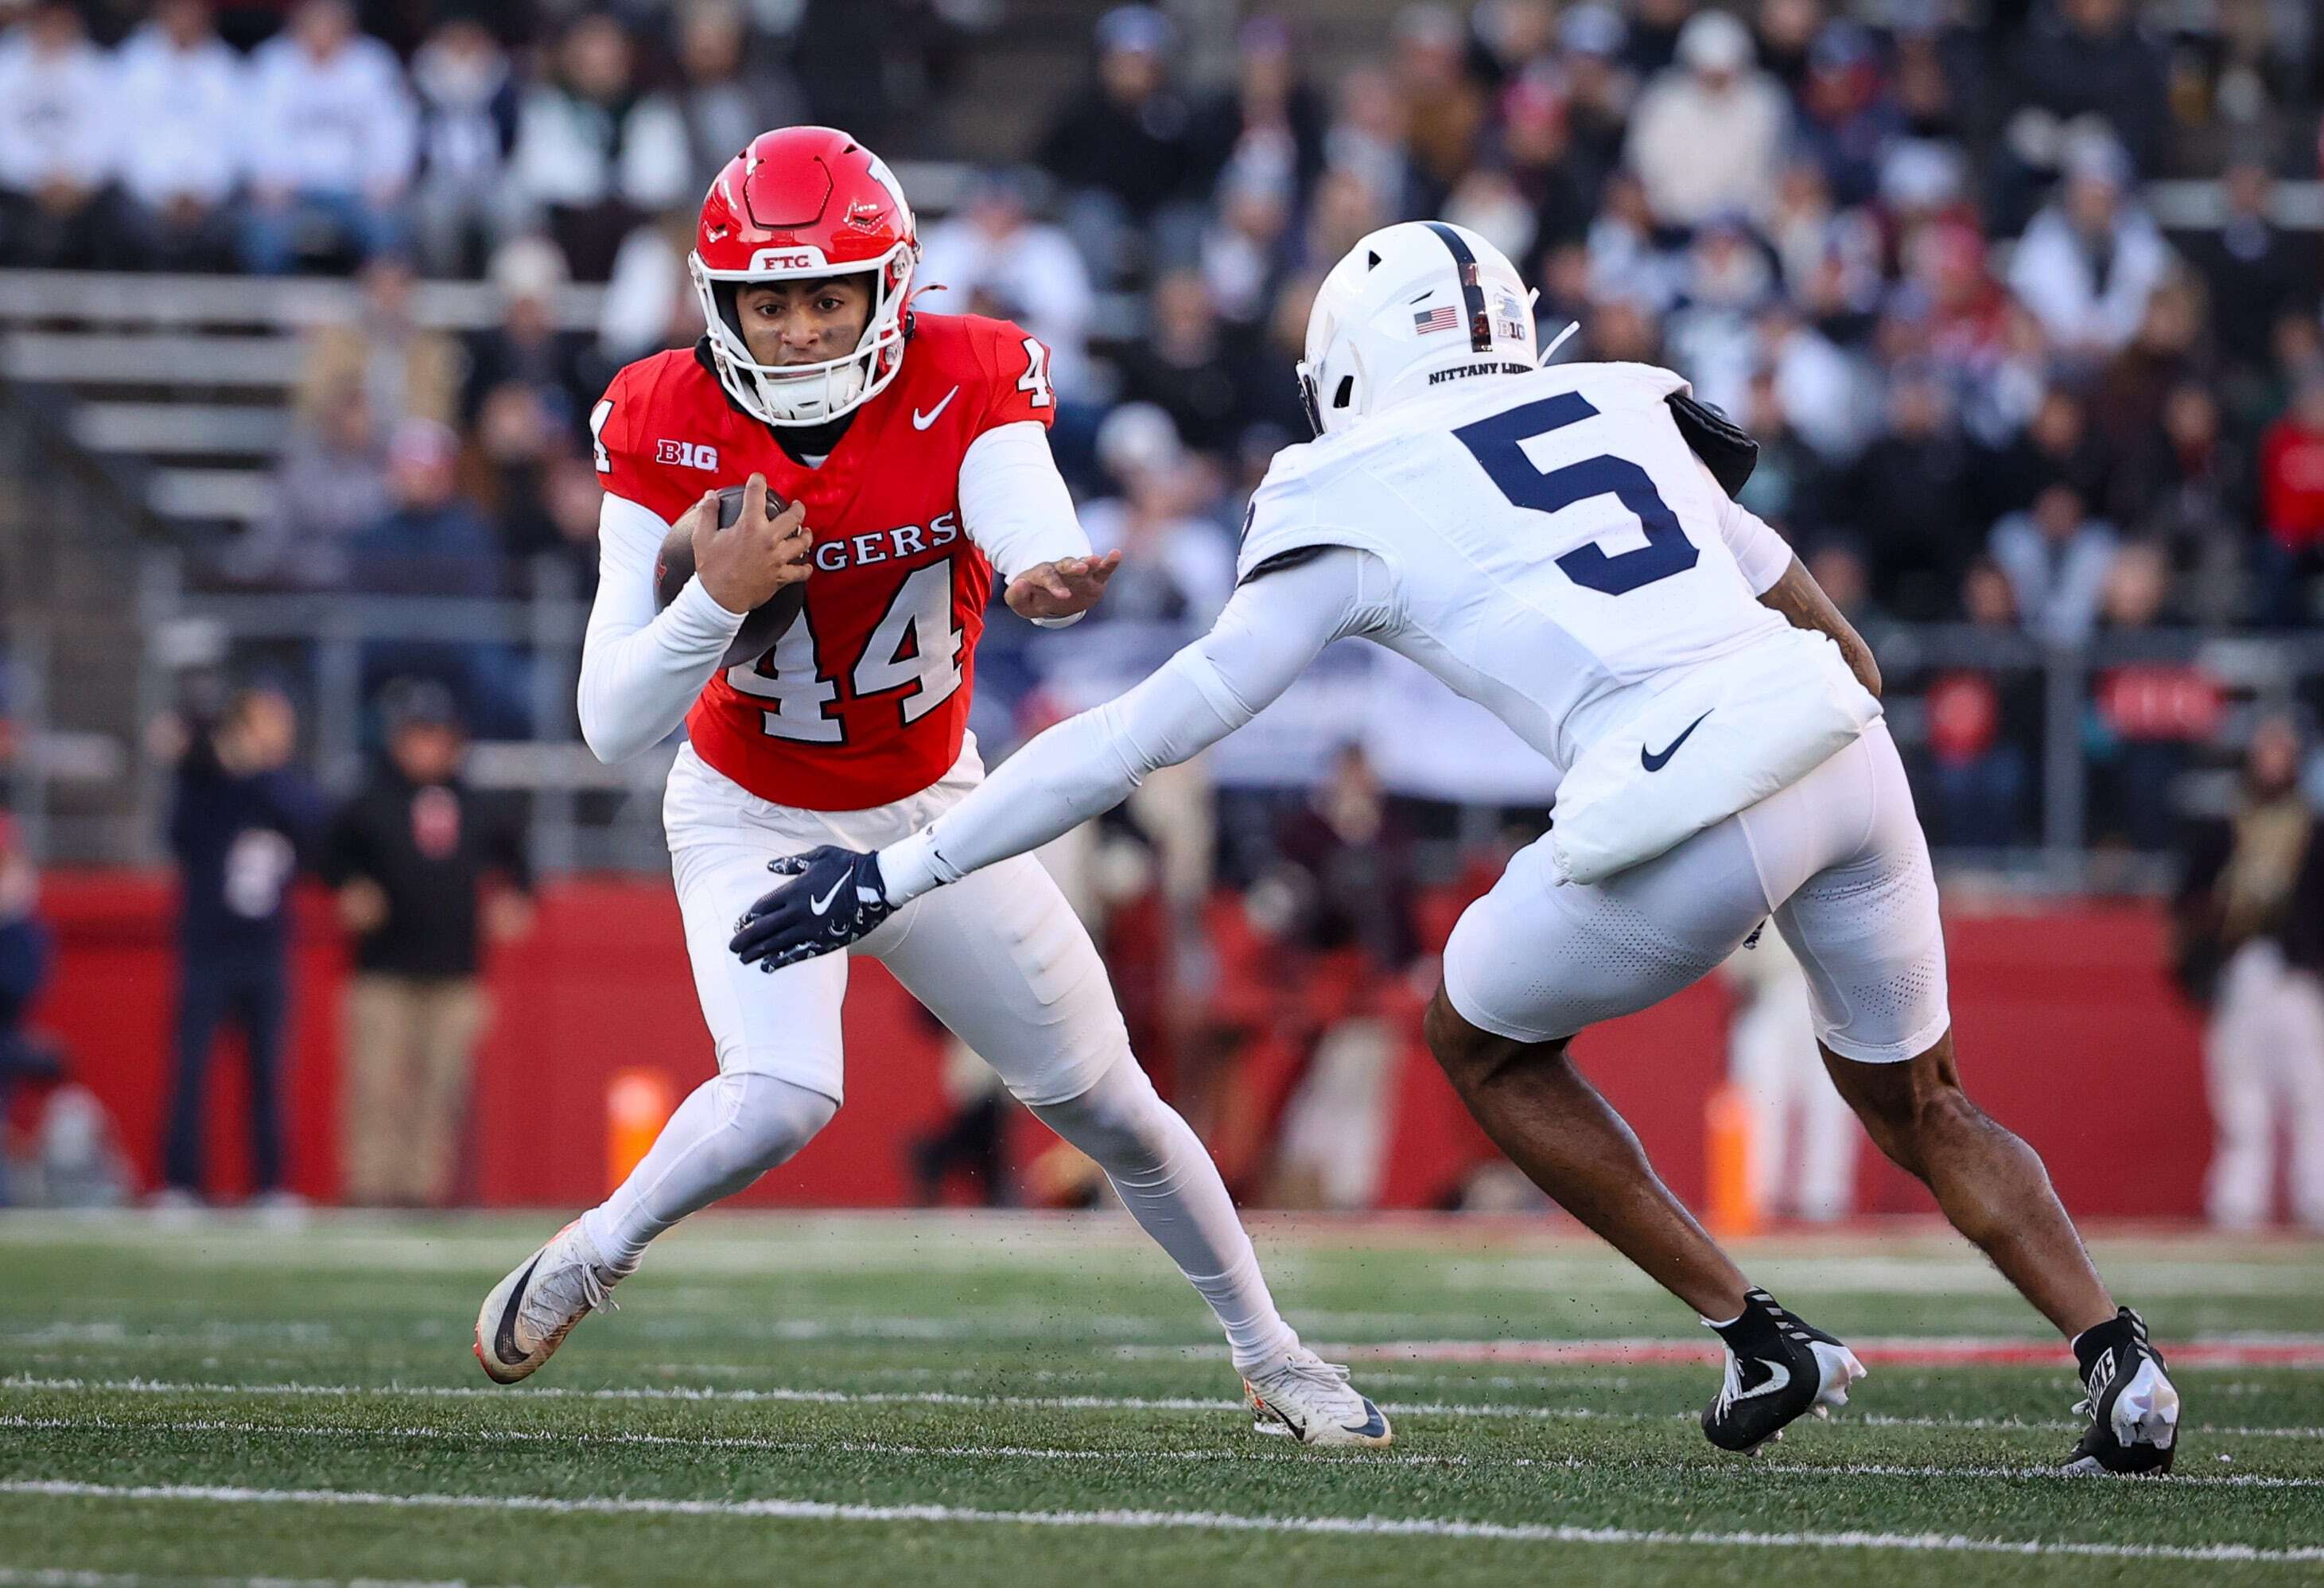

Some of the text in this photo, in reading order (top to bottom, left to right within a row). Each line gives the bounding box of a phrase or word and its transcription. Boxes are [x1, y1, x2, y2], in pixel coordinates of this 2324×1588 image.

[1428, 362, 1498, 386] NITTANY
[814, 511, 958, 571] GERS
[1450, 390, 1700, 597] 5
[725, 556, 965, 744] 44
